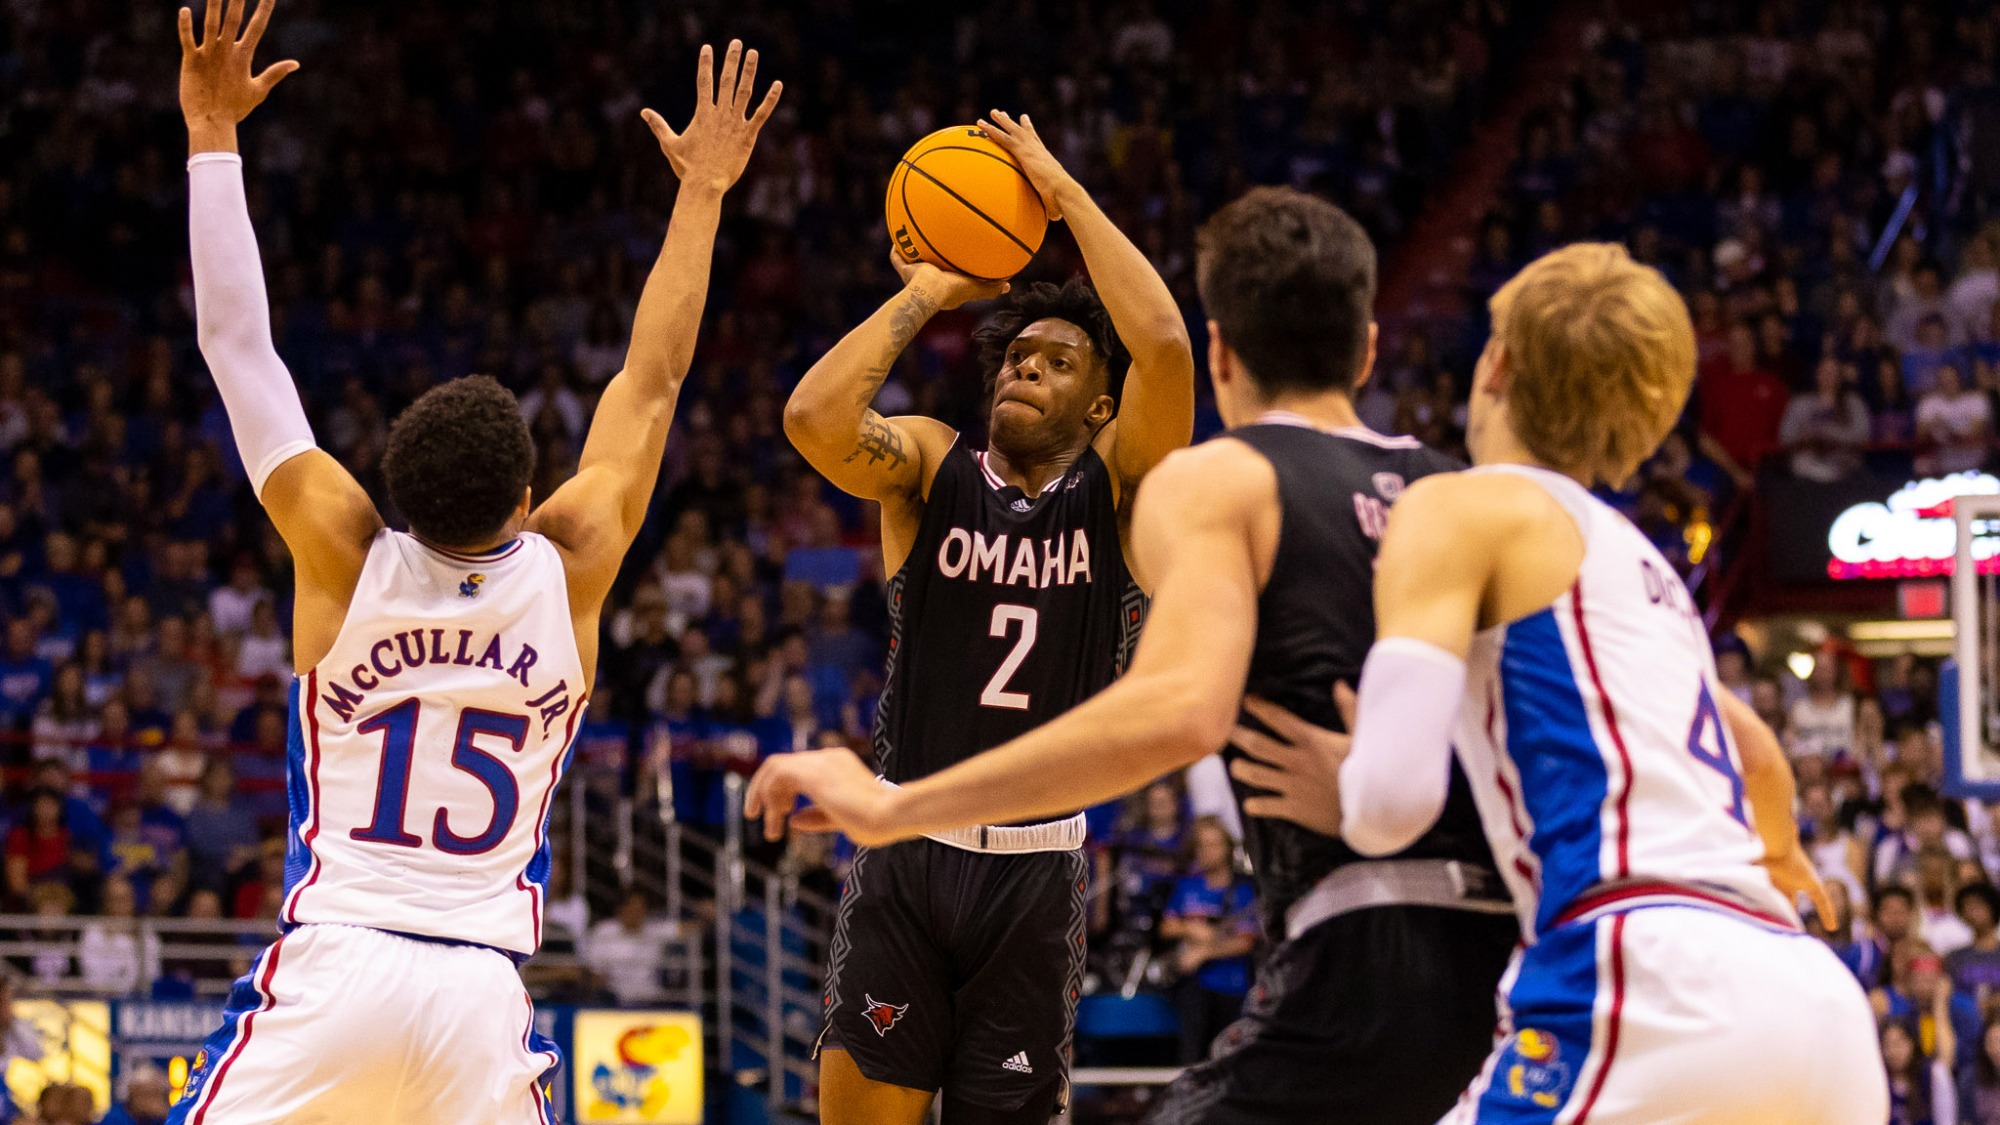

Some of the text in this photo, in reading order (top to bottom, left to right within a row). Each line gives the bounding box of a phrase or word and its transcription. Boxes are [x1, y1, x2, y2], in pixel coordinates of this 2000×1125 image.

[938, 526, 1093, 589] OMAHA
[979, 603, 1039, 711] 2
[524, 679, 570, 741] JR.
[1687, 670, 1753, 832] 4
[349, 696, 531, 856] 15
[1002, 1062, 1033, 1073] adidas
